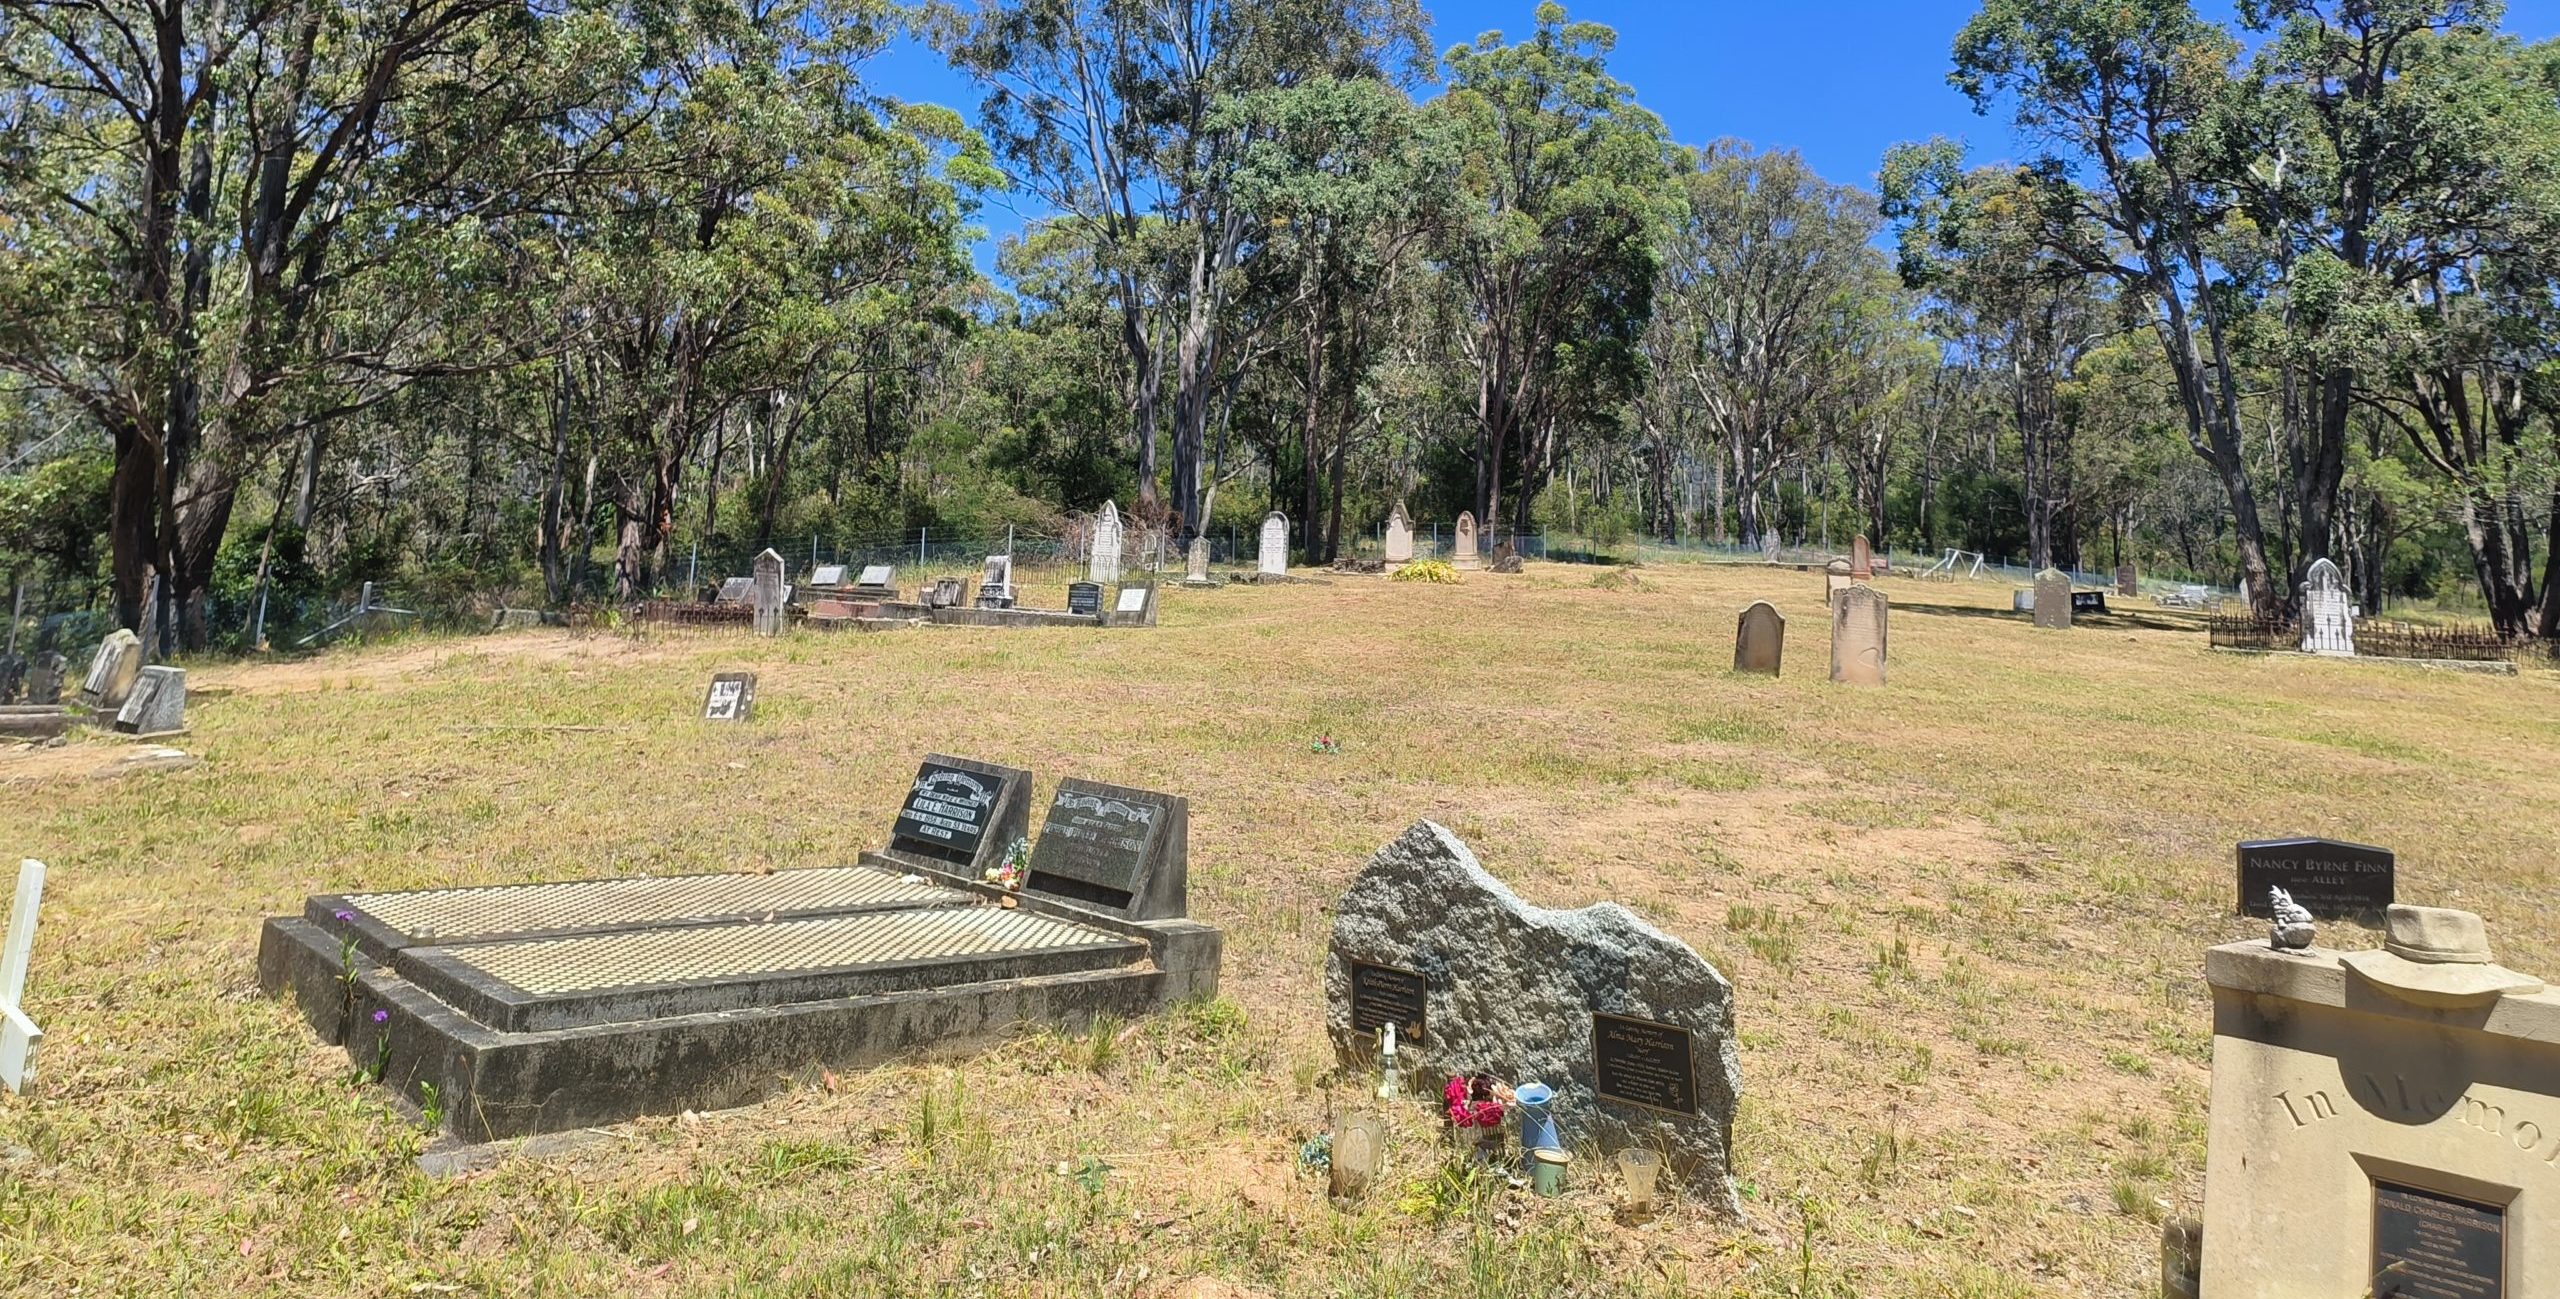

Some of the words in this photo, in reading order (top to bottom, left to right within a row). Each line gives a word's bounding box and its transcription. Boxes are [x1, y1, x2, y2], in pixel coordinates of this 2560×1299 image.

[915, 798, 931, 810] LILA
[939, 802, 975, 820] HARRISON
[2312, 876, 2345, 885] ALLEY
[2272, 1089, 2339, 1132] In
[2359, 1072, 2560, 1168] Memo
[2378, 1197, 2411, 1213] RONALD
[2413, 1205, 2453, 1221] CHARLES
[2454, 1215, 2501, 1233] HARRISON
